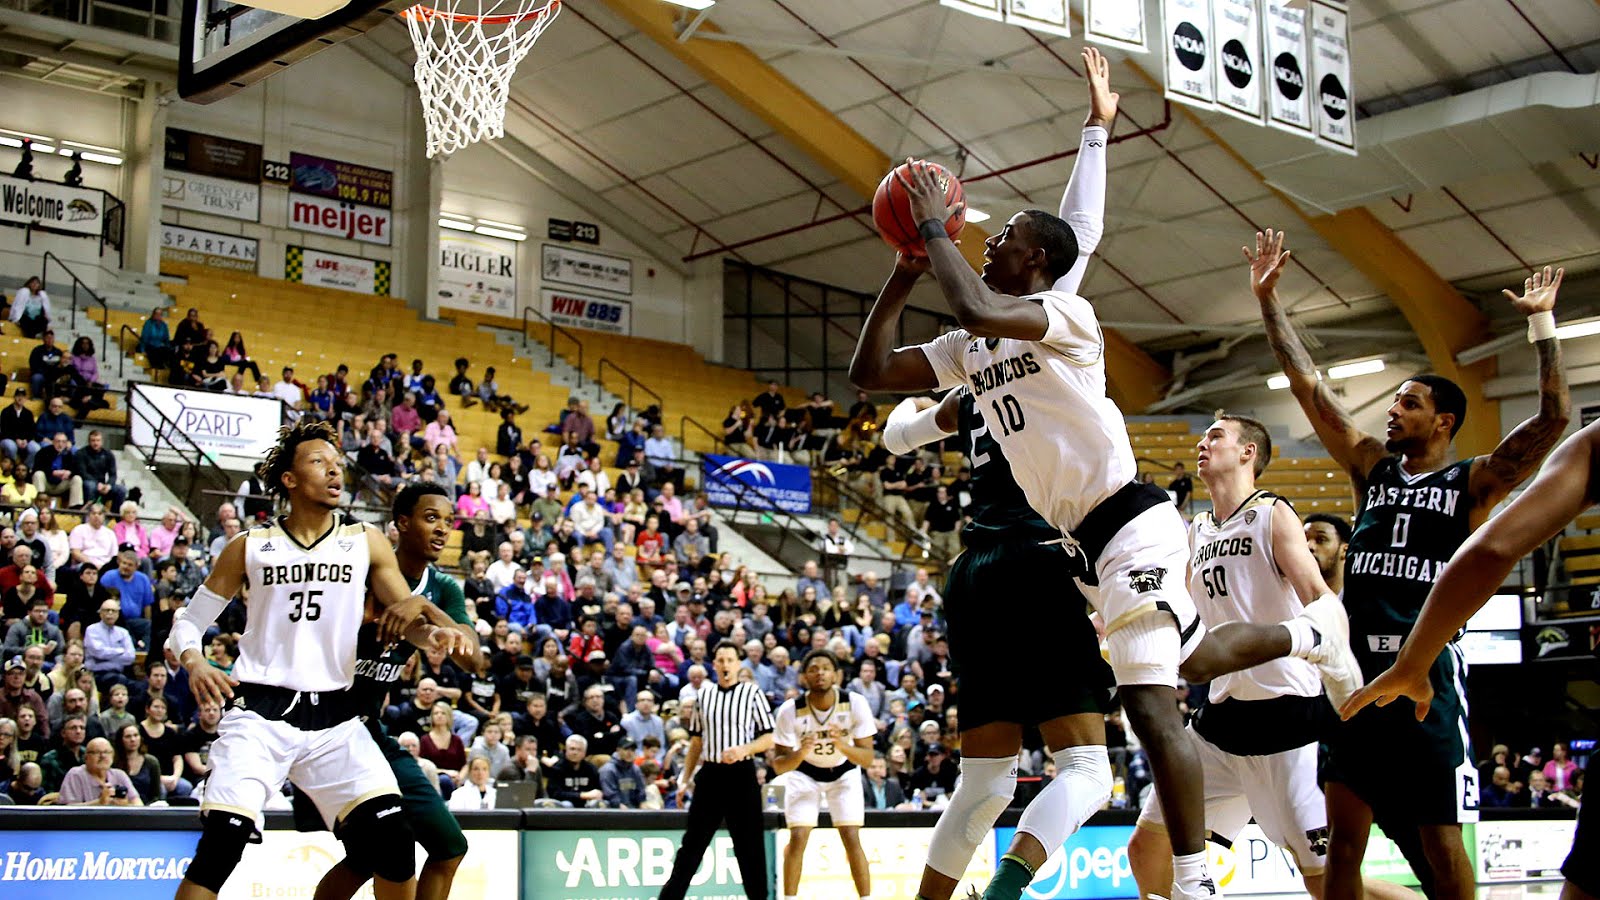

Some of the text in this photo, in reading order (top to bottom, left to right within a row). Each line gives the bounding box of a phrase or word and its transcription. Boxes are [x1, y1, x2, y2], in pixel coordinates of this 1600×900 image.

[264, 163, 290, 181] 212
[2, 183, 64, 221] Welcome
[188, 181, 257, 202] GREENLEAF
[201, 194, 241, 211] TRUST
[373, 190, 390, 206] FM
[293, 201, 386, 239] meijer
[575, 224, 596, 240] 213
[164, 232, 256, 258] SPARTAN
[441, 250, 512, 278] EIGLER
[551, 295, 587, 318] WIN
[969, 352, 1041, 396] BRONCOS
[992, 394, 1026, 437] 10
[1365, 484, 1460, 517] EASTERN
[1390, 512, 1411, 548] 0
[1193, 537, 1253, 567] BRONCOS
[262, 563, 353, 586] BRONCOS
[1202, 565, 1228, 600] 50
[1351, 552, 1452, 584] MICHIGAN
[288, 590, 323, 622] 35
[1377, 636, 1390, 651] E
[814, 743, 835, 755] 23
[1463, 774, 1480, 811] E
[1, 850, 193, 881] HOME MORTGAG
[1070, 847, 1132, 889] pep
[1249, 838, 1296, 879] PN
